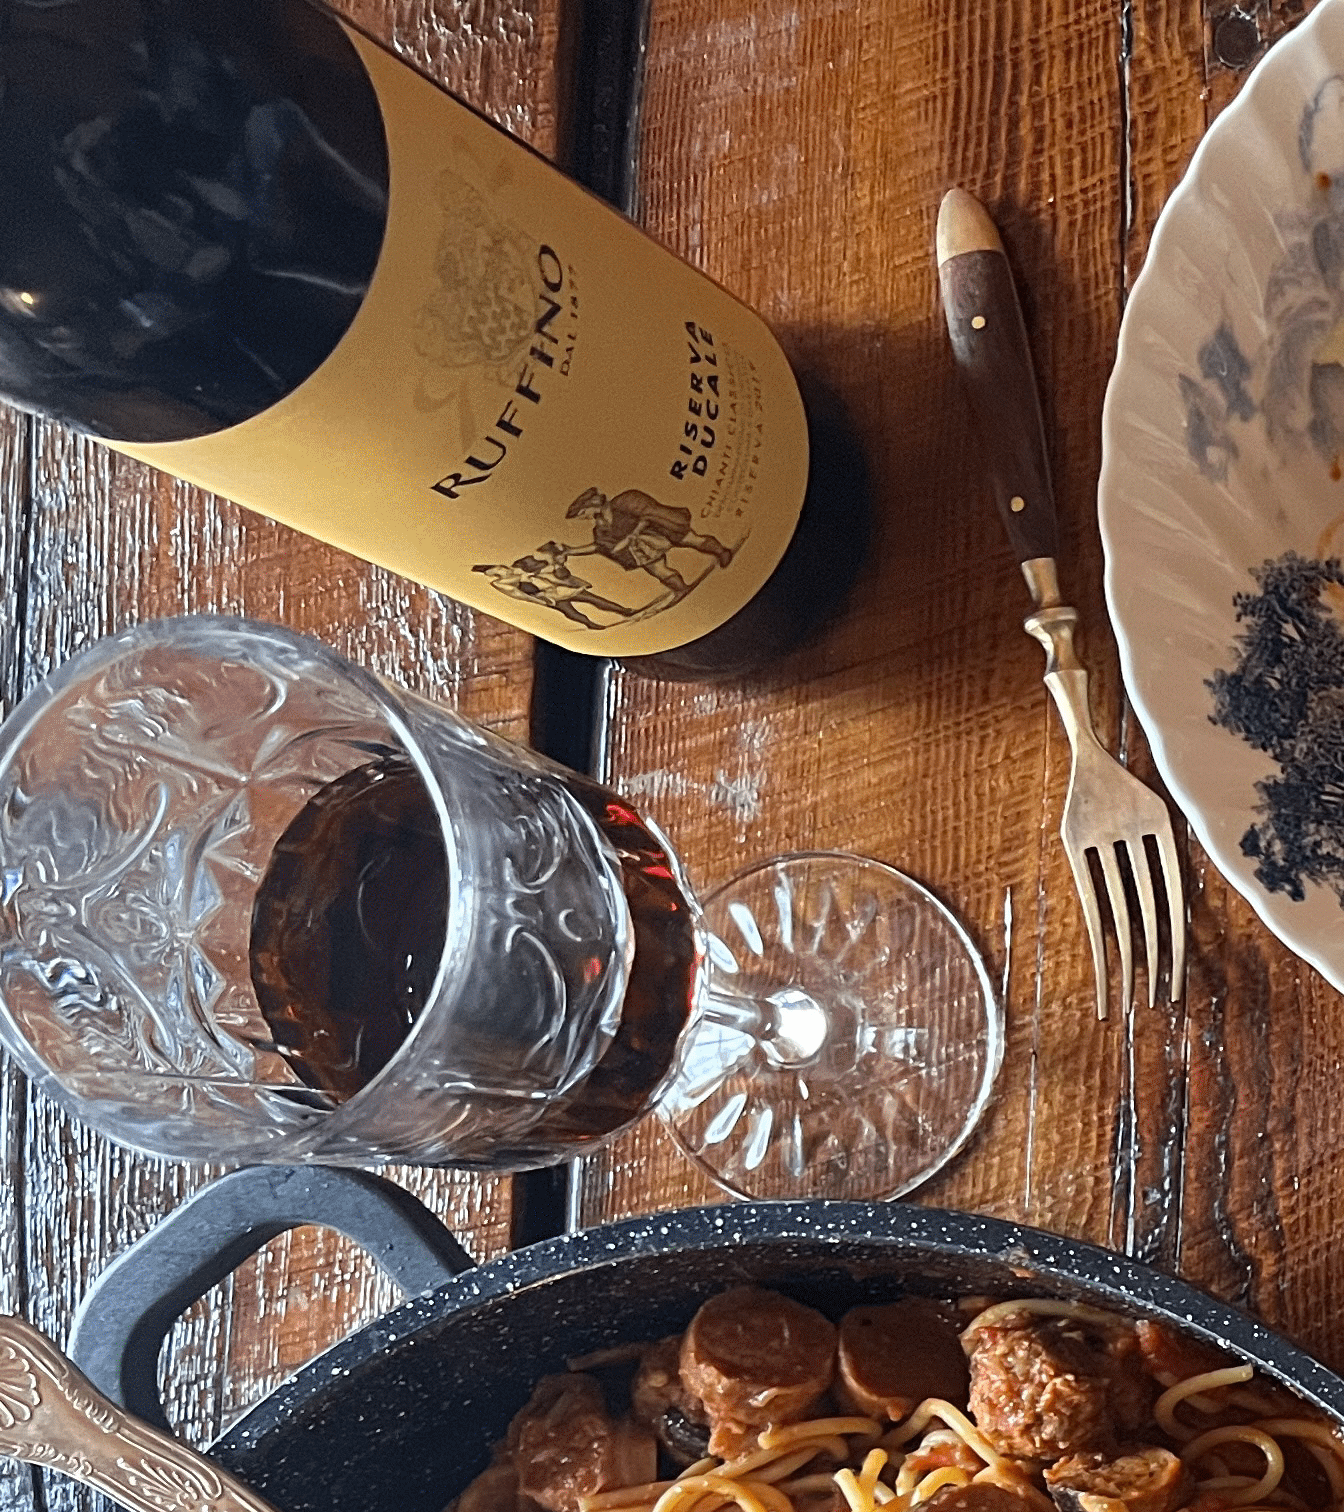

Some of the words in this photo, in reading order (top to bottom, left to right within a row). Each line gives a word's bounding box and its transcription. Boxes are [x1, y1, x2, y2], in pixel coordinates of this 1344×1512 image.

[429, 244, 563, 499] RUFFINO
[669, 321, 703, 481] RISERVA
[691, 326, 720, 478] DUCALE
